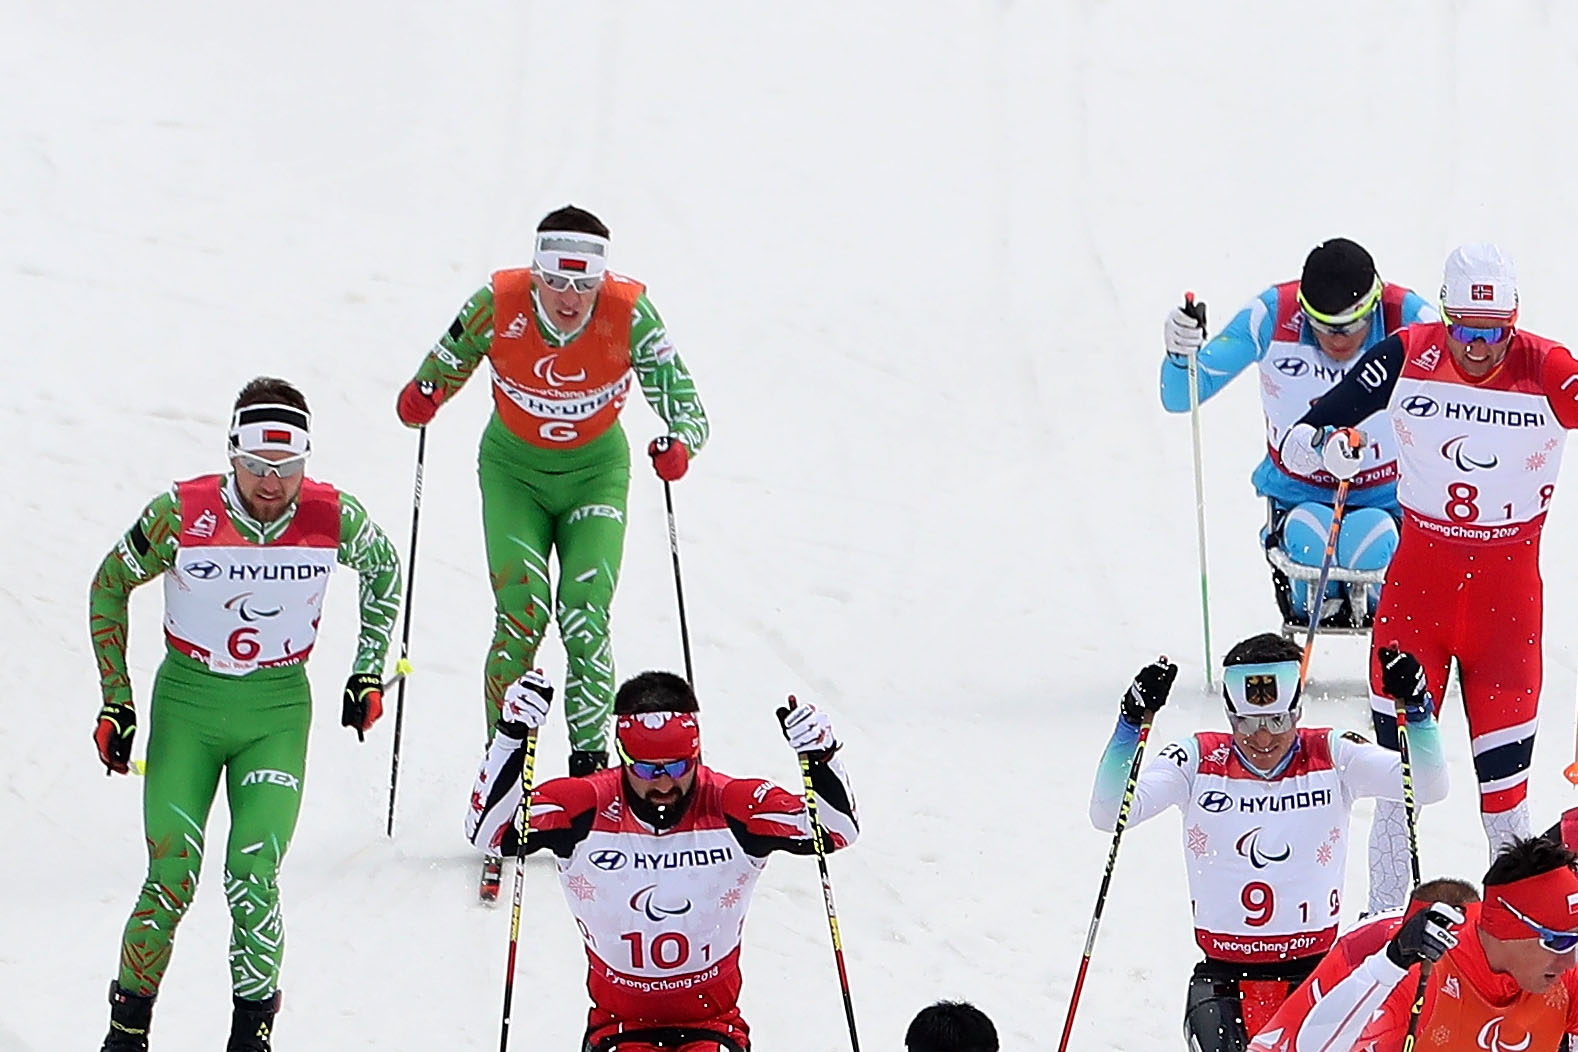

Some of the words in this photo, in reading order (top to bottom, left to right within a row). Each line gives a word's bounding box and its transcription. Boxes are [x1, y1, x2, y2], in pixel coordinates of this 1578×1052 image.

[1445, 402, 1545, 427] HYUNDAI
[539, 421, 579, 442] G
[568, 504, 624, 524] ATEX
[1444, 482, 1479, 523] 8
[1503, 503, 1513, 520] 1
[227, 627, 261, 661] 6
[1159, 743, 1188, 768] ER
[241, 769, 299, 791] ATEX
[1119, 778, 1137, 826] LEKI
[1240, 789, 1331, 813] HYUNDAI
[634, 847, 733, 871] HYUNDAI
[1241, 881, 1275, 927] 9
[1298, 902, 1308, 923] 1
[621, 932, 690, 970] 10
[701, 944, 711, 962] 1
[606, 967, 692, 992] PyeongChang
[693, 966, 719, 984] 2018
